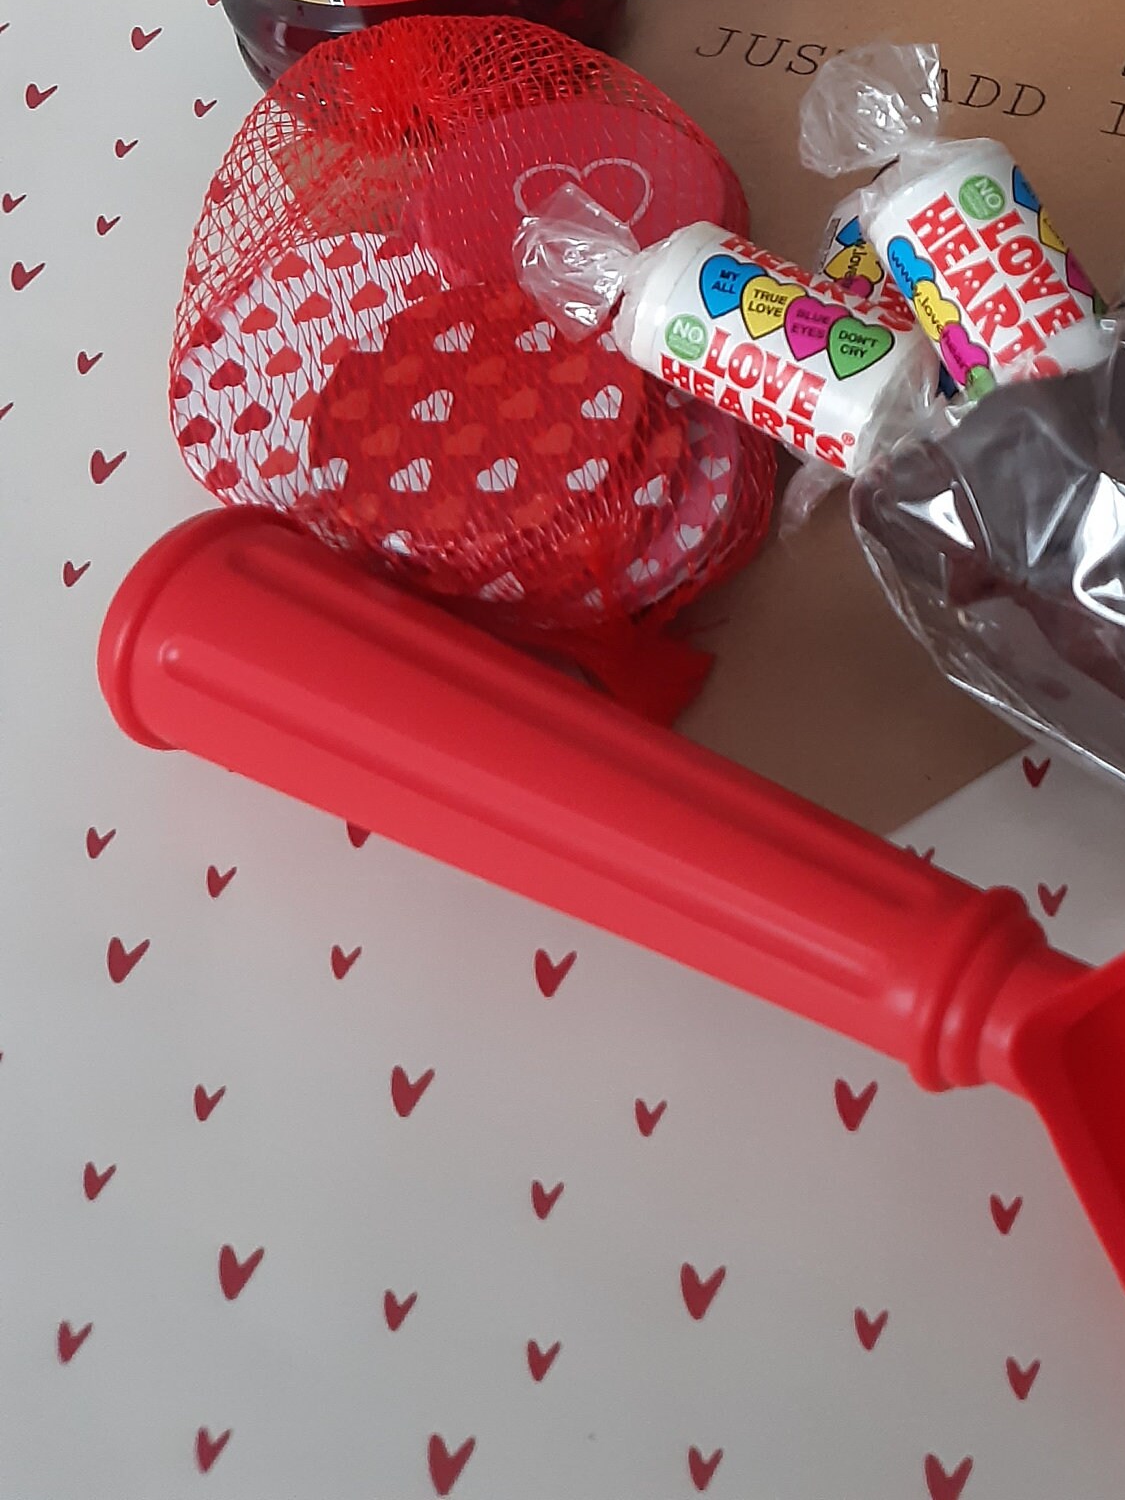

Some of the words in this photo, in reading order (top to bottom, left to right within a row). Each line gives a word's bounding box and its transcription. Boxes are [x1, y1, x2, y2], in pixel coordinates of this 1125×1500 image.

[696, 26, 845, 76] JUS
[976, 178, 1002, 209] NO
[719, 268, 739, 281] MY
[977, 209, 1086, 338] LOVE
[711, 281, 737, 295] ALL
[753, 289, 789, 306] TRUE
[748, 301, 784, 318] LOVE
[796, 308, 831, 325] BLUE
[673, 320, 705, 344] NO
[791, 324, 825, 340] EYES
[838, 330, 879, 349] DON'T
[840, 343, 868, 359] CRY
[702, 327, 828, 422] LOVE
[660, 354, 850, 470] HEARTS
